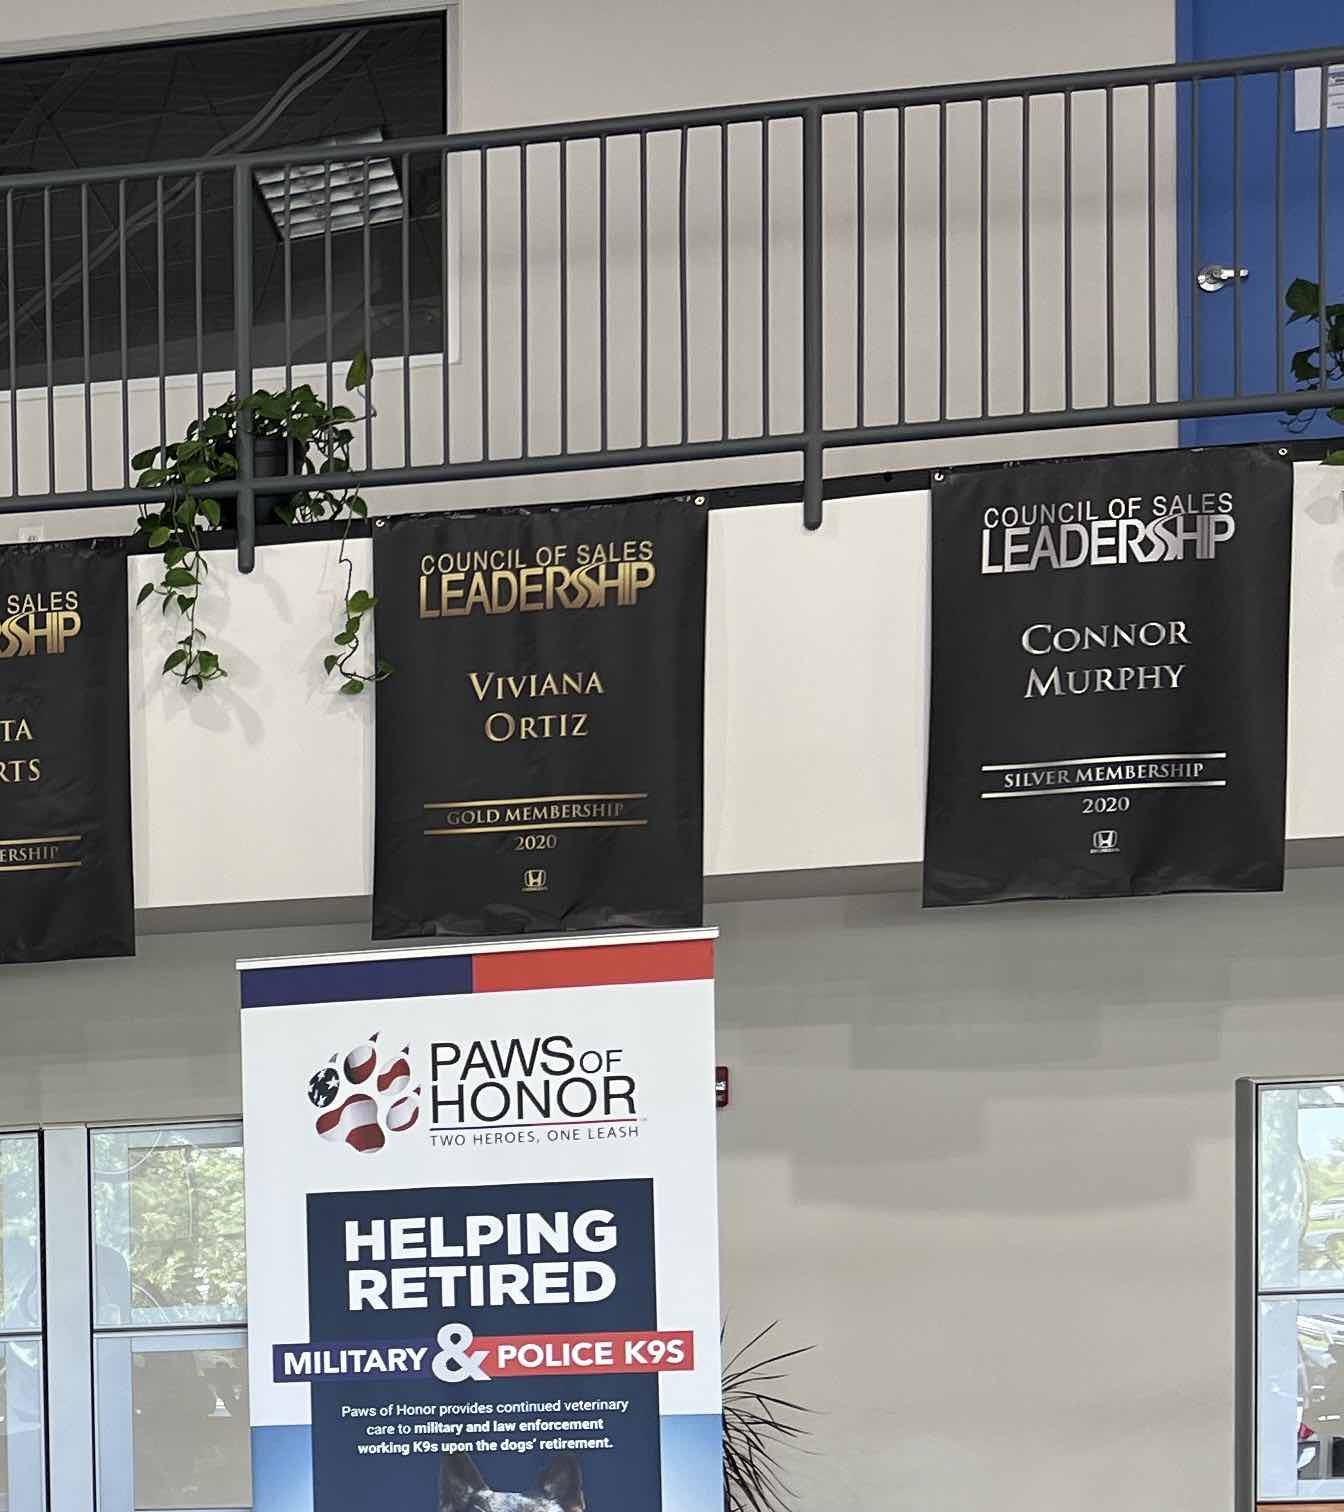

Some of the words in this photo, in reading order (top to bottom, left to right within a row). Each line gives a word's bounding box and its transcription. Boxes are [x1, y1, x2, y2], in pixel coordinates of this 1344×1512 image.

[984, 501, 1099, 529] COUNCIL
[1108, 496, 1142, 520] OF
[1153, 492, 1233, 515] SALES
[420, 548, 527, 575] COUNCIL
[536, 545, 567, 567] OF
[577, 540, 654, 563] SALES
[981, 512, 1236, 575] LEADERSHIP
[7, 591, 79, 612] SALES
[419, 560, 656, 619] LEADERSHIP
[1021, 620, 1192, 655] CONNOR
[468, 671, 606, 701] VIVIANA
[1024, 664, 1186, 699] MURPHY
[484, 712, 589, 742] ORTIZ
[1004, 770, 1070, 789] SILVER
[1075, 763, 1204, 784] MEMBERSHIP
[447, 809, 499, 825] GOLD
[505, 803, 624, 823] MEMBERSHIP
[1082, 797, 1130, 815] 2020
[514, 834, 557, 851] 2020
[431, 1035, 575, 1082] PAWS
[579, 1049, 623, 1075] OF
[432, 1075, 636, 1124] HONOR
[431, 1134, 466, 1147] TWO
[473, 1130, 541, 1145] HEROES,
[547, 1129, 580, 1142] ONE
[588, 1126, 639, 1140] LEASH
[344, 1209, 618, 1263] HELPING
[347, 1261, 617, 1312] RETIRED
[282, 1346, 429, 1376] MILITARY
[430, 1322, 492, 1383] &
[497, 1339, 613, 1369] POLICE
[624, 1338, 685, 1365] K9S
[341, 1405, 377, 1417] Paws
[380, 1404, 393, 1416] of
[396, 1404, 436, 1416] Honor
[439, 1401, 494, 1417] provides
[496, 1400, 561, 1414] continued
[563, 1399, 629, 1413] veterinary
[366, 1424, 395, 1436] care
[397, 1423, 411, 1435] to
[414, 1421, 463, 1436] military
[466, 1421, 490, 1434] and
[493, 1420, 516, 1432] law
[519, 1418, 604, 1432] enforcement
[358, 1441, 410, 1456] working
[413, 1441, 438, 1453] K9s
[441, 1441, 474, 1455] upon
[476, 1440, 497, 1451] the
[539, 1437, 613, 1451] retirement.
